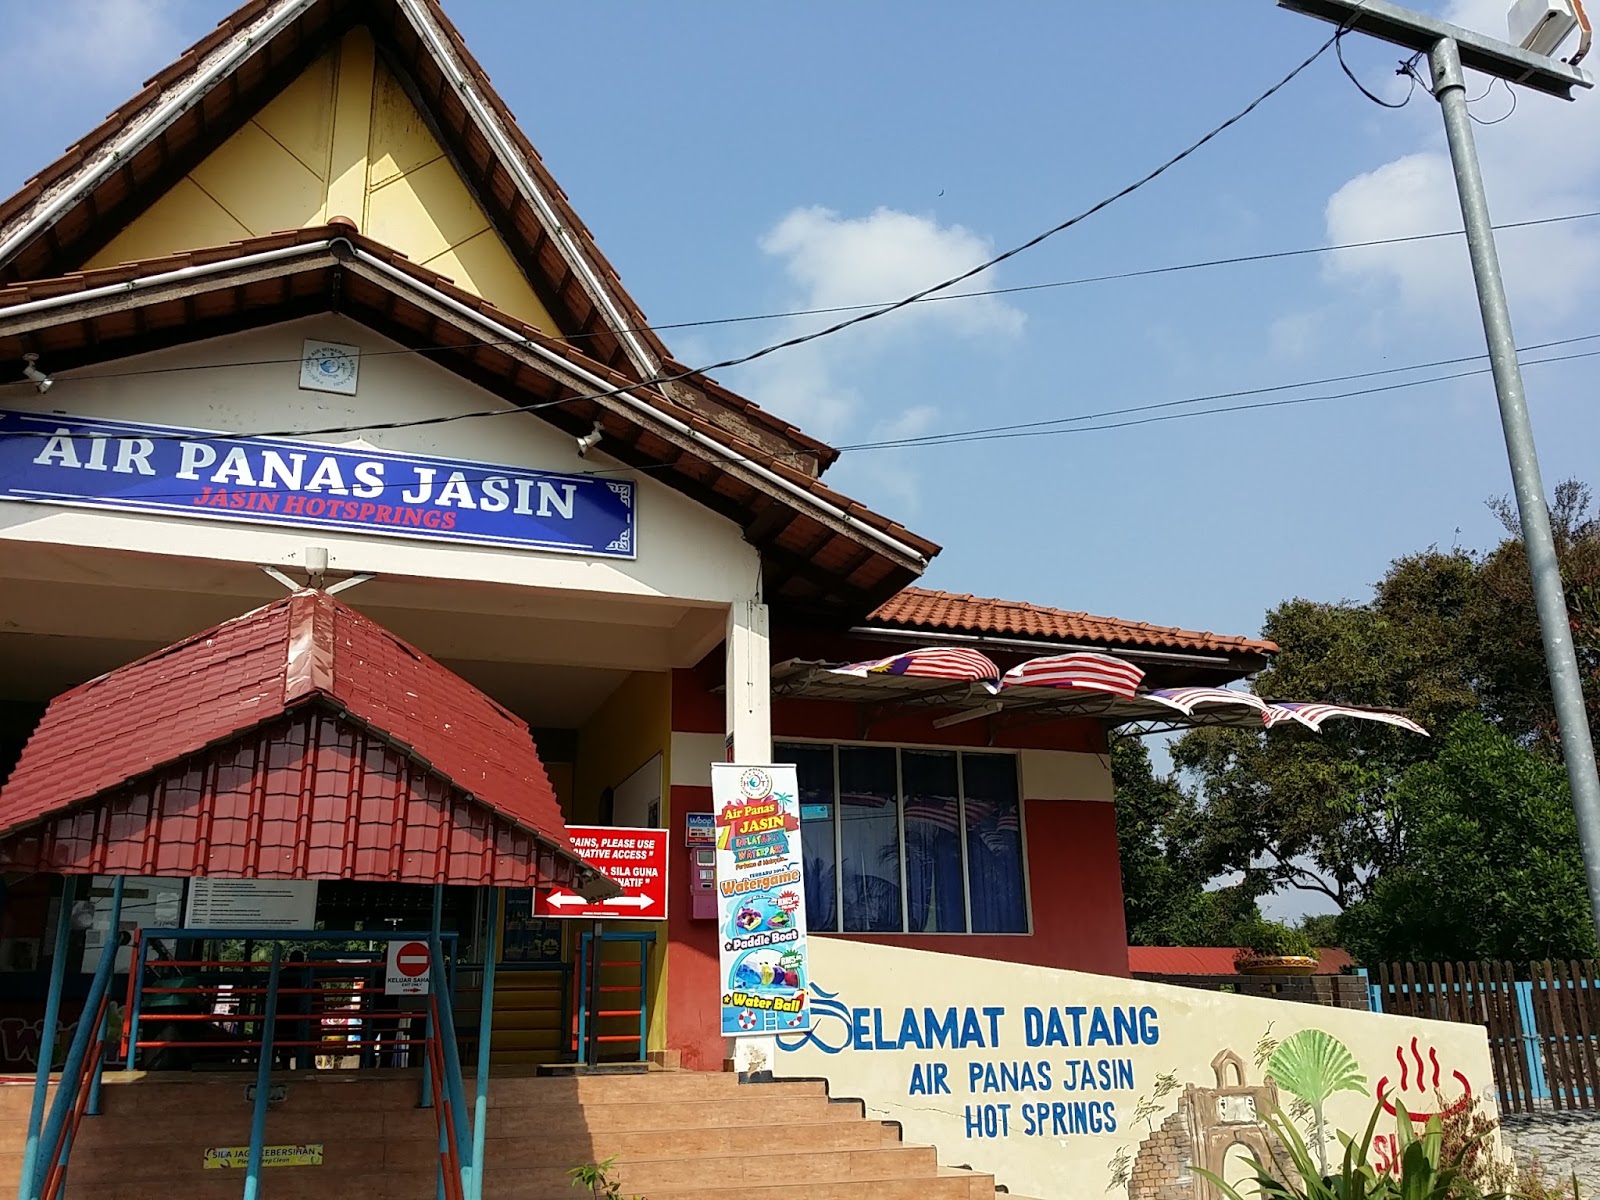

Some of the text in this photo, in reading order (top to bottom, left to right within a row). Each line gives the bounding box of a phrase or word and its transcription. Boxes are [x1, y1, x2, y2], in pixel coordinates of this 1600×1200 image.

[33, 427, 578, 520] AIR PANAS JASIN
[194, 486, 457, 530] JASIN HOTSPRINGS
[724, 804, 775, 820] Air Panas
[739, 814, 785, 833] JASIN
[601, 838, 636, 848] PLEASE
[637, 840, 656, 849] USE
[611, 850, 647, 860] ACCESS
[610, 866, 631, 876] SILA
[632, 867, 658, 877] GUNA
[720, 869, 800, 896] Watergame
[732, 928, 798, 950] Paddle Boat
[732, 993, 802, 1013] Water Ball
[776, 982, 1160, 1054] SELAMAT DATANG
[909, 1059, 1134, 1095] AIR PANAS JASIN
[965, 1101, 1117, 1138] HOT SPRINGS
[212, 1150, 232, 1158] SILA
[233, 1150, 249, 1158] JAG
